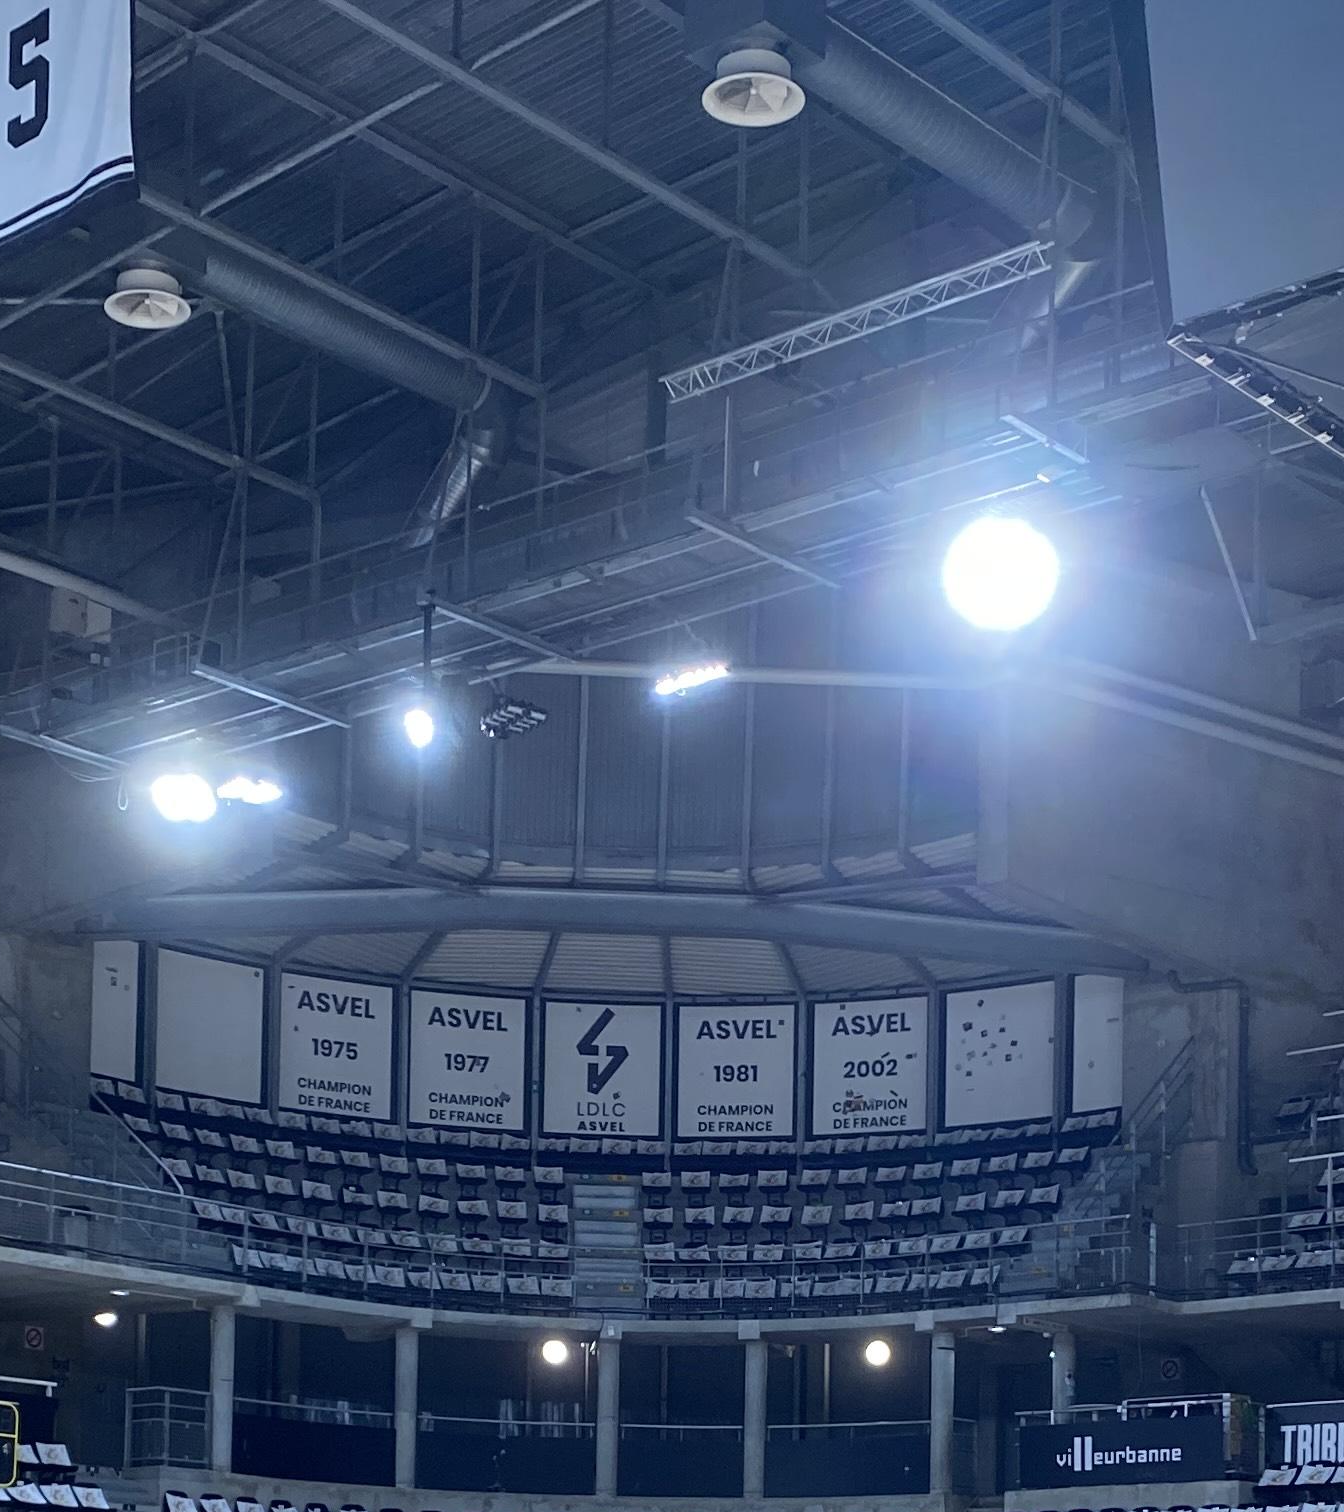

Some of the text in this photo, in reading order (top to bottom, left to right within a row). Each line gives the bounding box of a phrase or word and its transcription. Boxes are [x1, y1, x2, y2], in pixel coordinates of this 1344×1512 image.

[6, 8, 50, 149] 5
[297, 989, 376, 1020] ASVEL
[427, 1006, 509, 1032] ASVEL
[696, 1018, 777, 1041] ASVEL
[831, 1012, 912, 1038] ASVEL
[311, 1037, 358, 1061] 1975
[444, 1053, 490, 1074] 1977
[712, 1063, 759, 1084] 1981
[843, 1058, 899, 1079] 2002
[296, 1076, 373, 1097] CHAMPION
[297, 1094, 371, 1114] DE FRANCE
[427, 1091, 505, 1109] CHAMPION
[576, 1100, 627, 1117] LDLC
[697, 1103, 775, 1117] CHAMPION
[429, 1108, 504, 1126] DE FRANCE
[577, 1121, 626, 1133] ASVEL
[697, 1119, 774, 1133] DE FRANCE
[832, 1114, 908, 1130] DE FRANCE
[1056, 1436, 1182, 1472] villeurbanne
